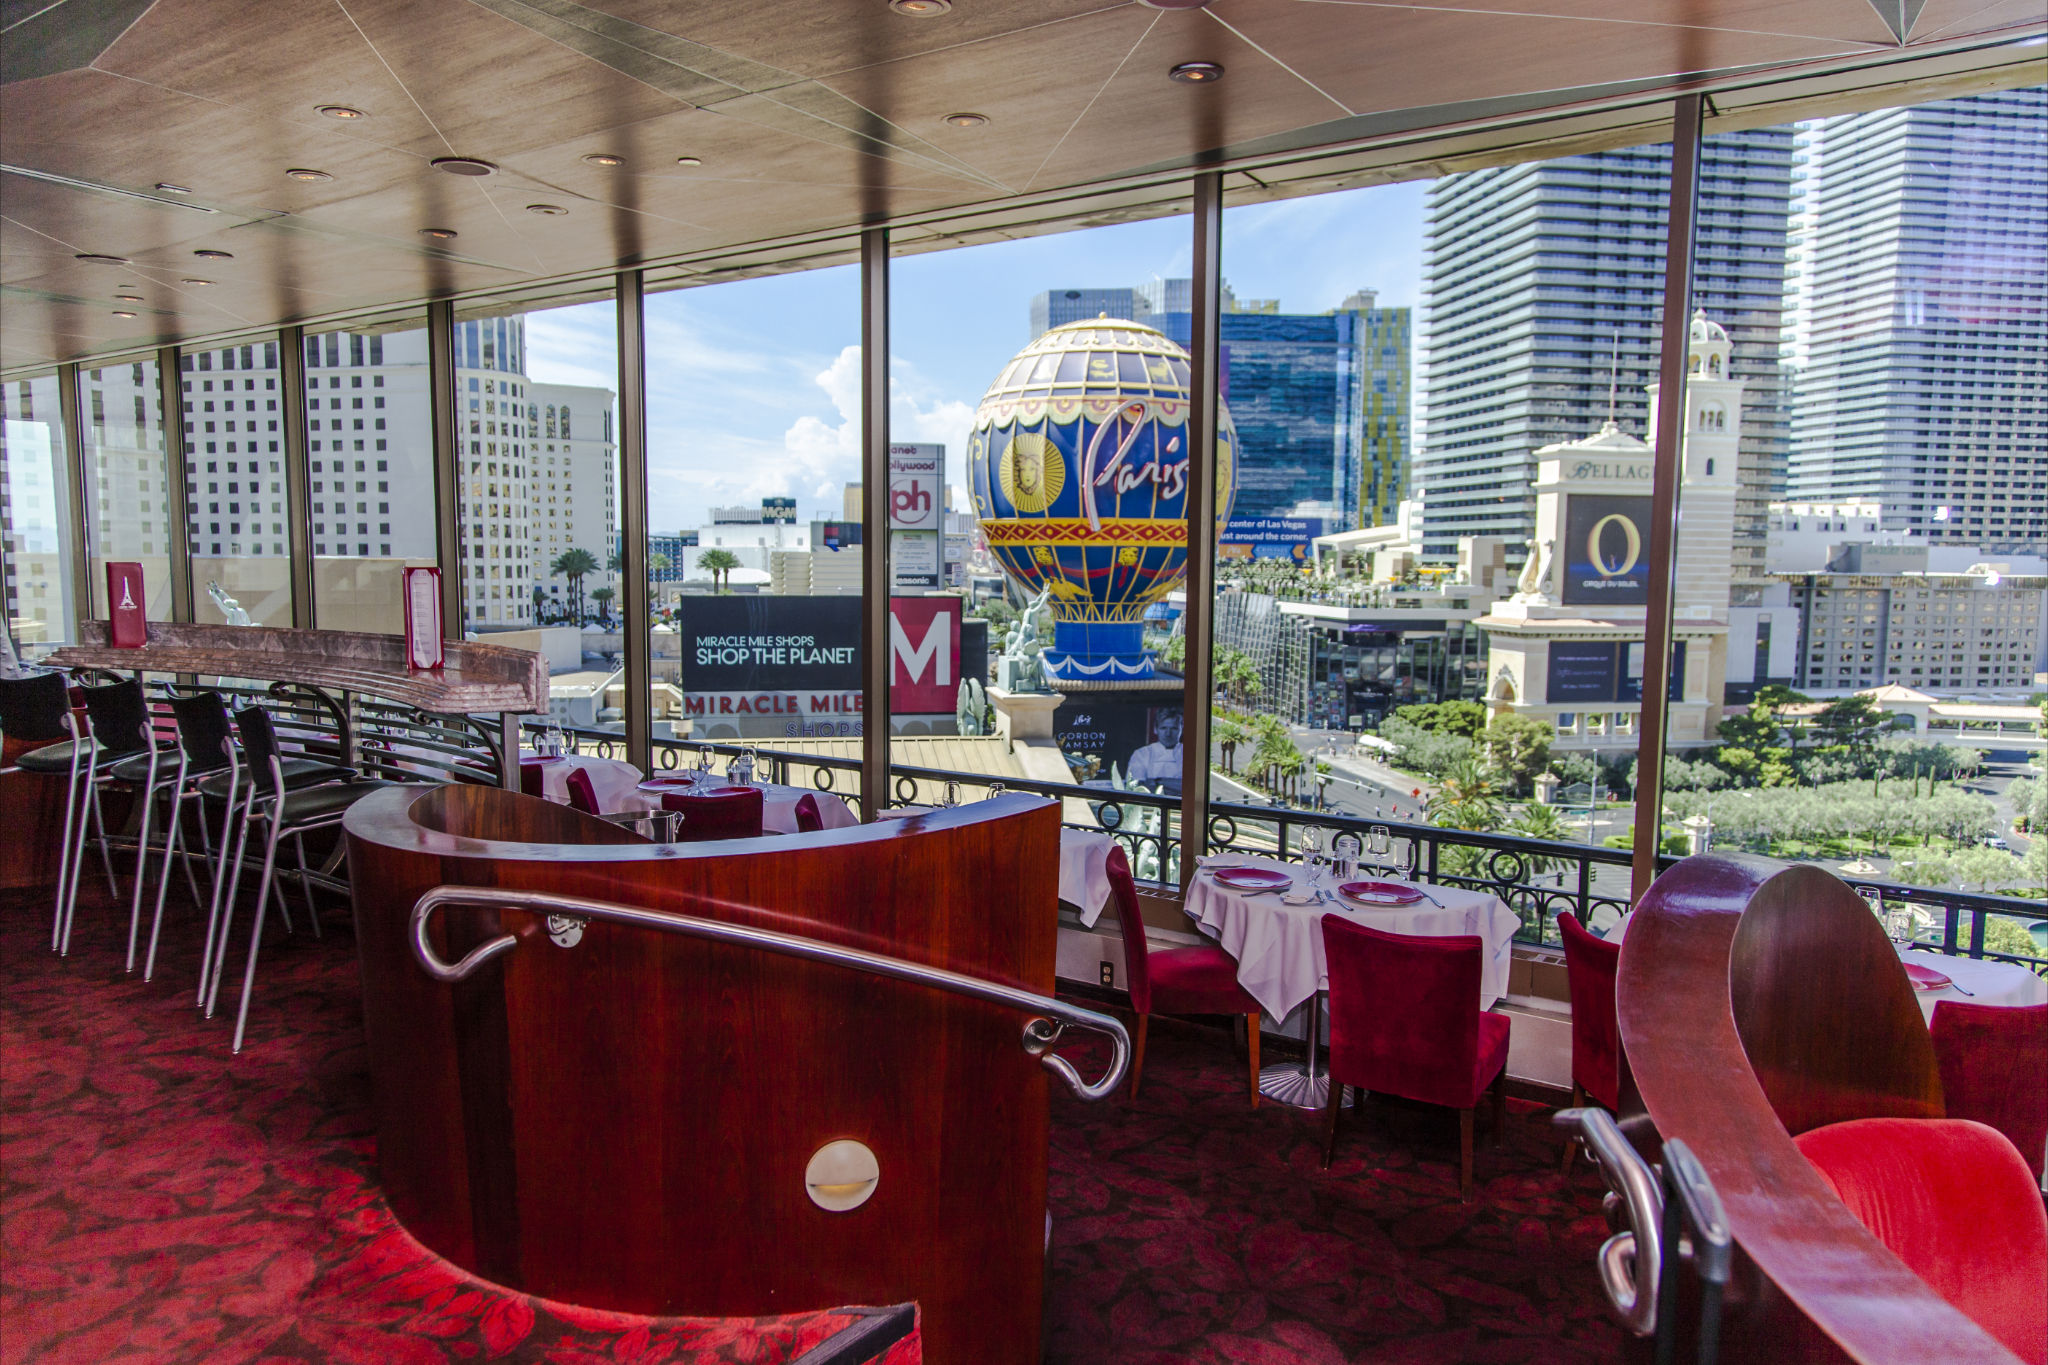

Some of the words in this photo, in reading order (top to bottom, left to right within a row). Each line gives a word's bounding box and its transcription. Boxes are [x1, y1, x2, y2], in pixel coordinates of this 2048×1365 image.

[891, 446, 917, 455] anet
[889, 459, 935, 471] ollywood
[1084, 398, 1189, 532] Paris
[1566, 461, 1654, 479] BELLAG
[891, 480, 931, 520] ph
[762, 506, 796, 519] MGM
[1228, 520, 1255, 529] center
[1256, 519, 1266, 528] of
[1267, 519, 1281, 529] Las
[1281, 520, 1307, 530] Vegas
[1219, 532, 1234, 540] ust
[1235, 532, 1265, 540] around
[1265, 532, 1279, 540] the
[1280, 533, 1309, 541] corner.
[696, 636, 746, 647] MIRACLE
[748, 636, 774, 647] MILE
[775, 635, 815, 647] SHOPS
[890, 611, 951, 687] M
[696, 647, 750, 666] SHOP
[752, 648, 787, 665] THE
[790, 647, 855, 665] PLANET
[685, 695, 799, 714] MIRACLE
[810, 694, 864, 713] MILE
[786, 721, 864, 738] SHOPS
[1058, 732, 1106, 740] GORDON
[1065, 741, 1105, 749] AMSAY
